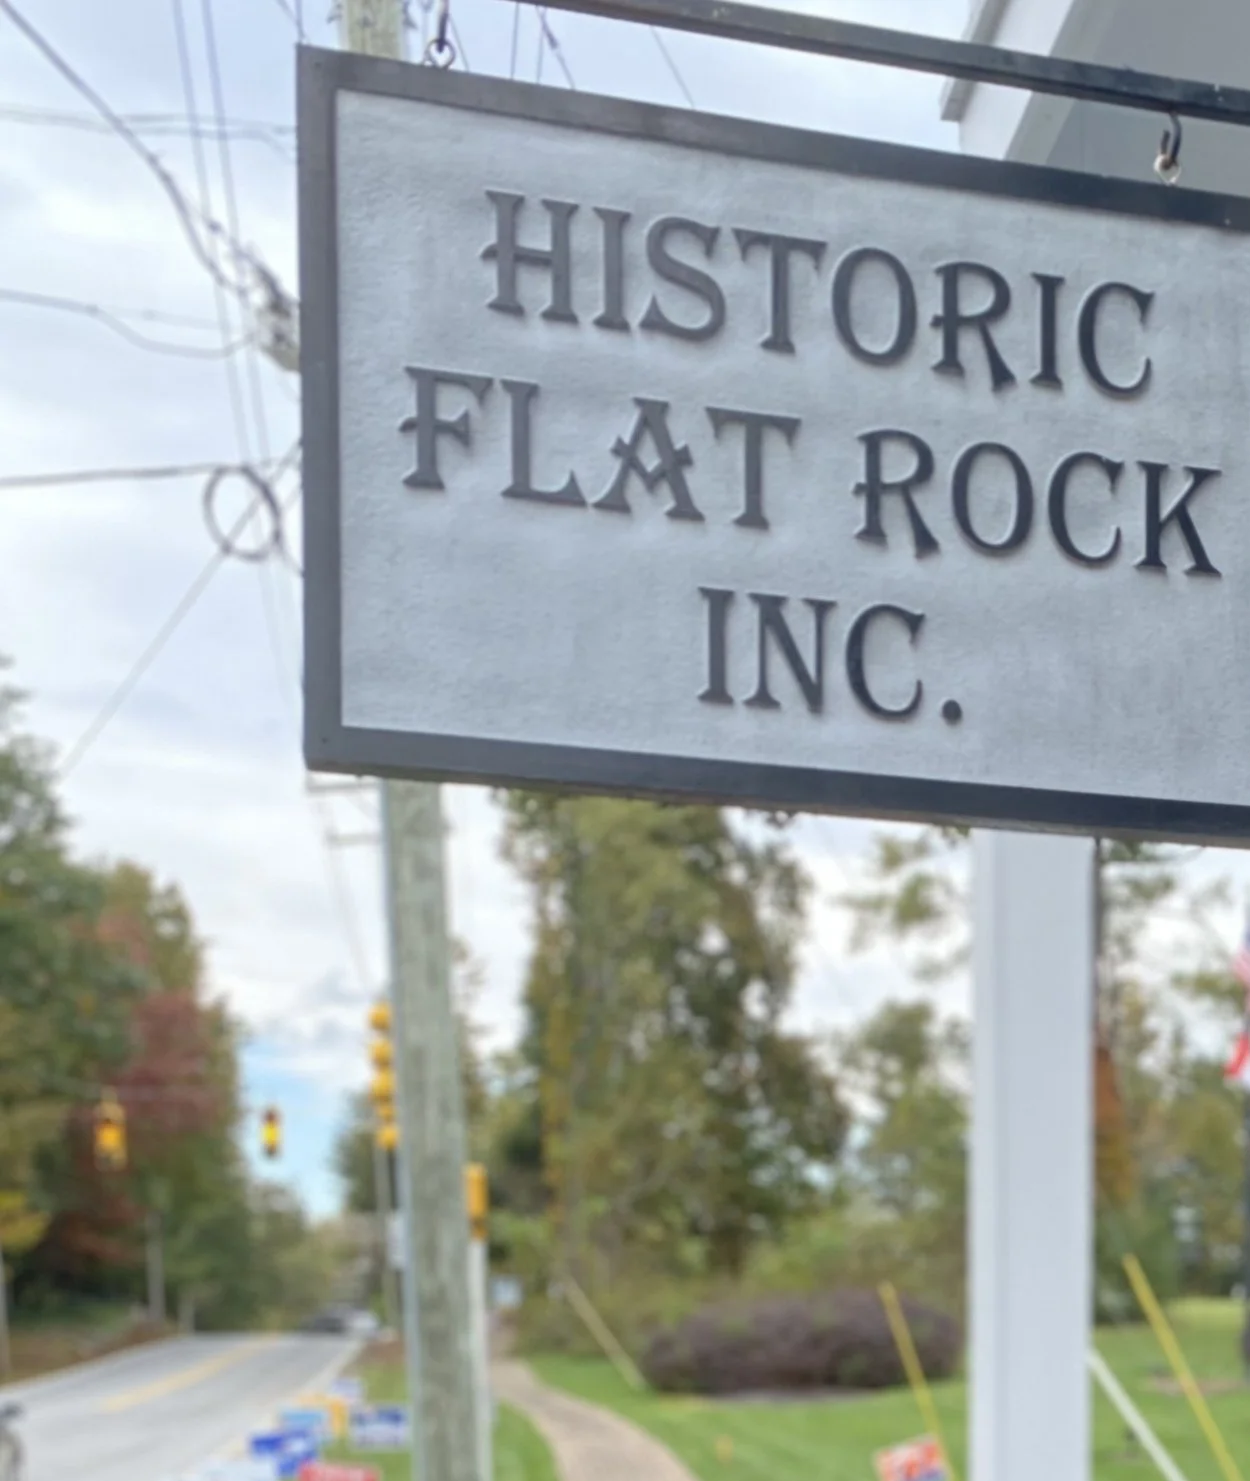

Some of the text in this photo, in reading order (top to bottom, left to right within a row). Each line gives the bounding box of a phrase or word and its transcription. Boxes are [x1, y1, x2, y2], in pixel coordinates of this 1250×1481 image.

[480, 189, 1156, 399] HISTORIC
[398, 366, 1223, 578] FLAT ROCK
[697, 586, 963, 725] INC.
